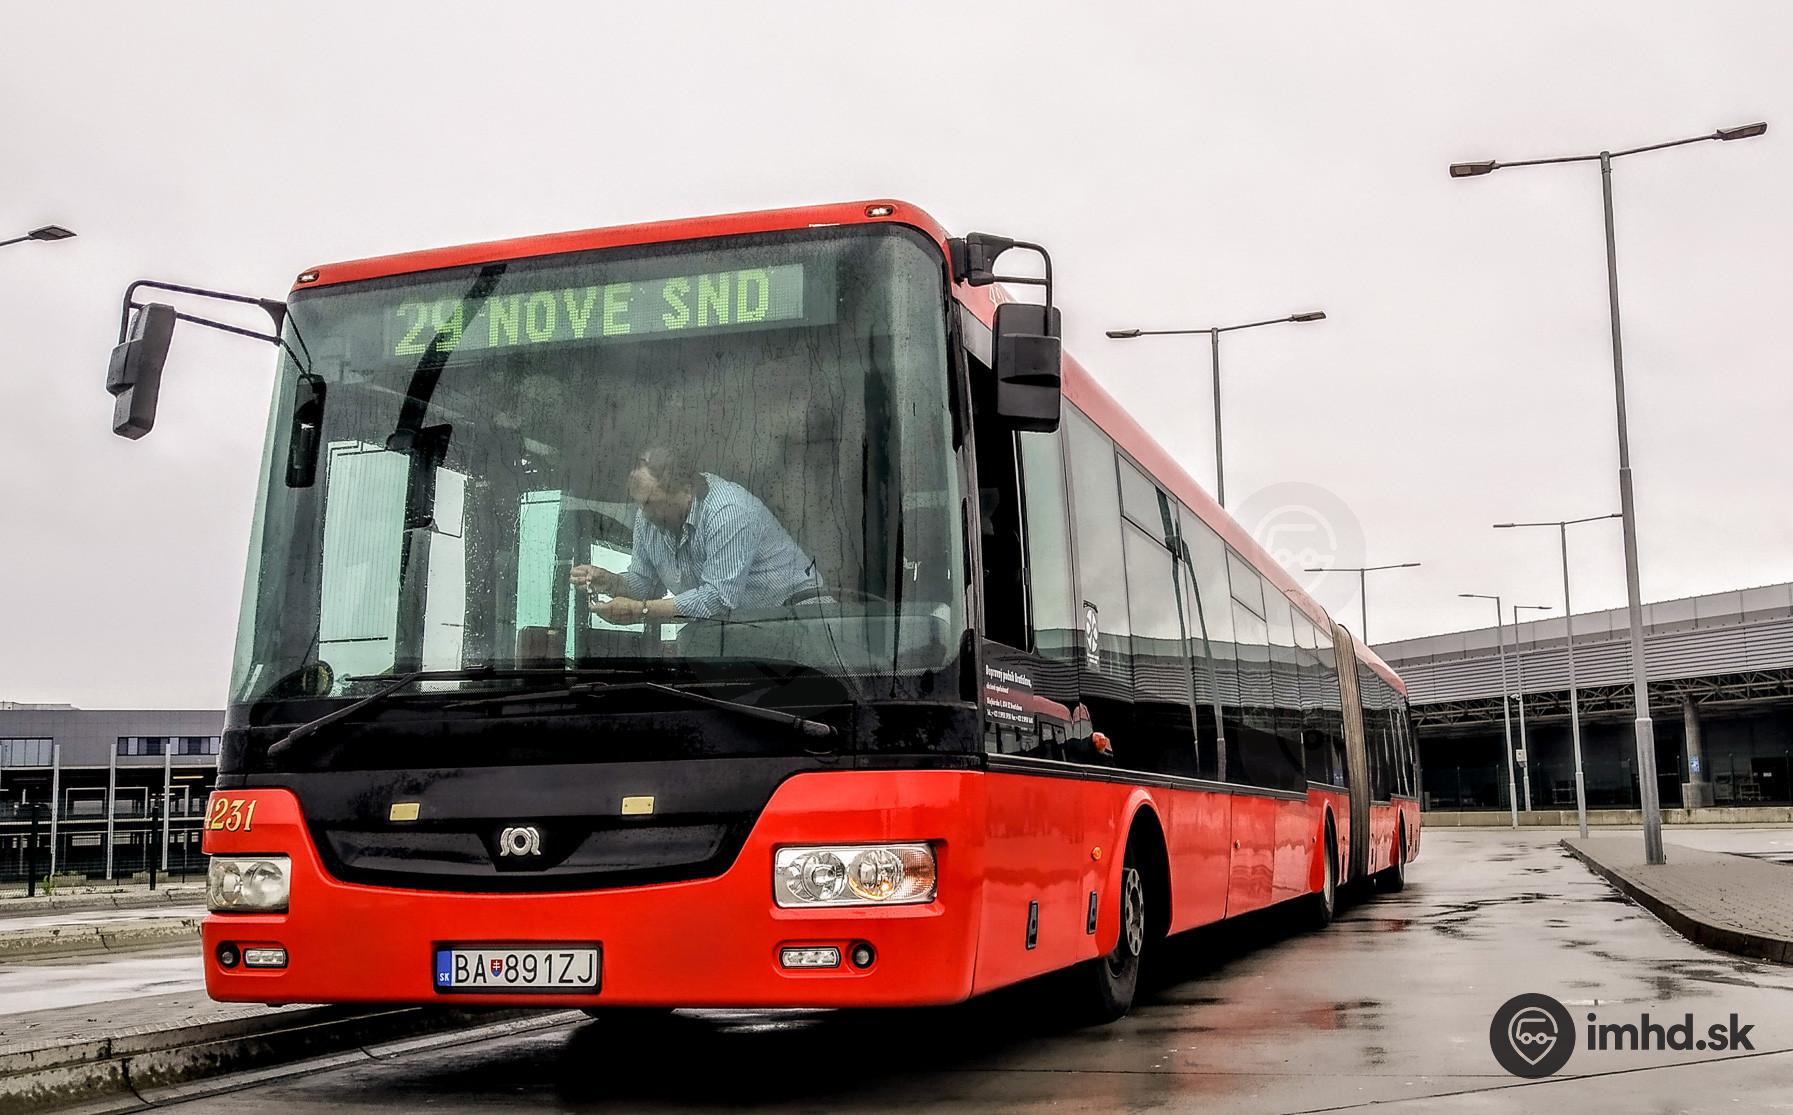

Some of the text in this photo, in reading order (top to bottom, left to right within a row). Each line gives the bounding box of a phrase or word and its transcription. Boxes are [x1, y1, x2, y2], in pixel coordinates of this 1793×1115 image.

[395, 268, 769, 356] 29 NOVE SND
[439, 972, 450, 982] SK
